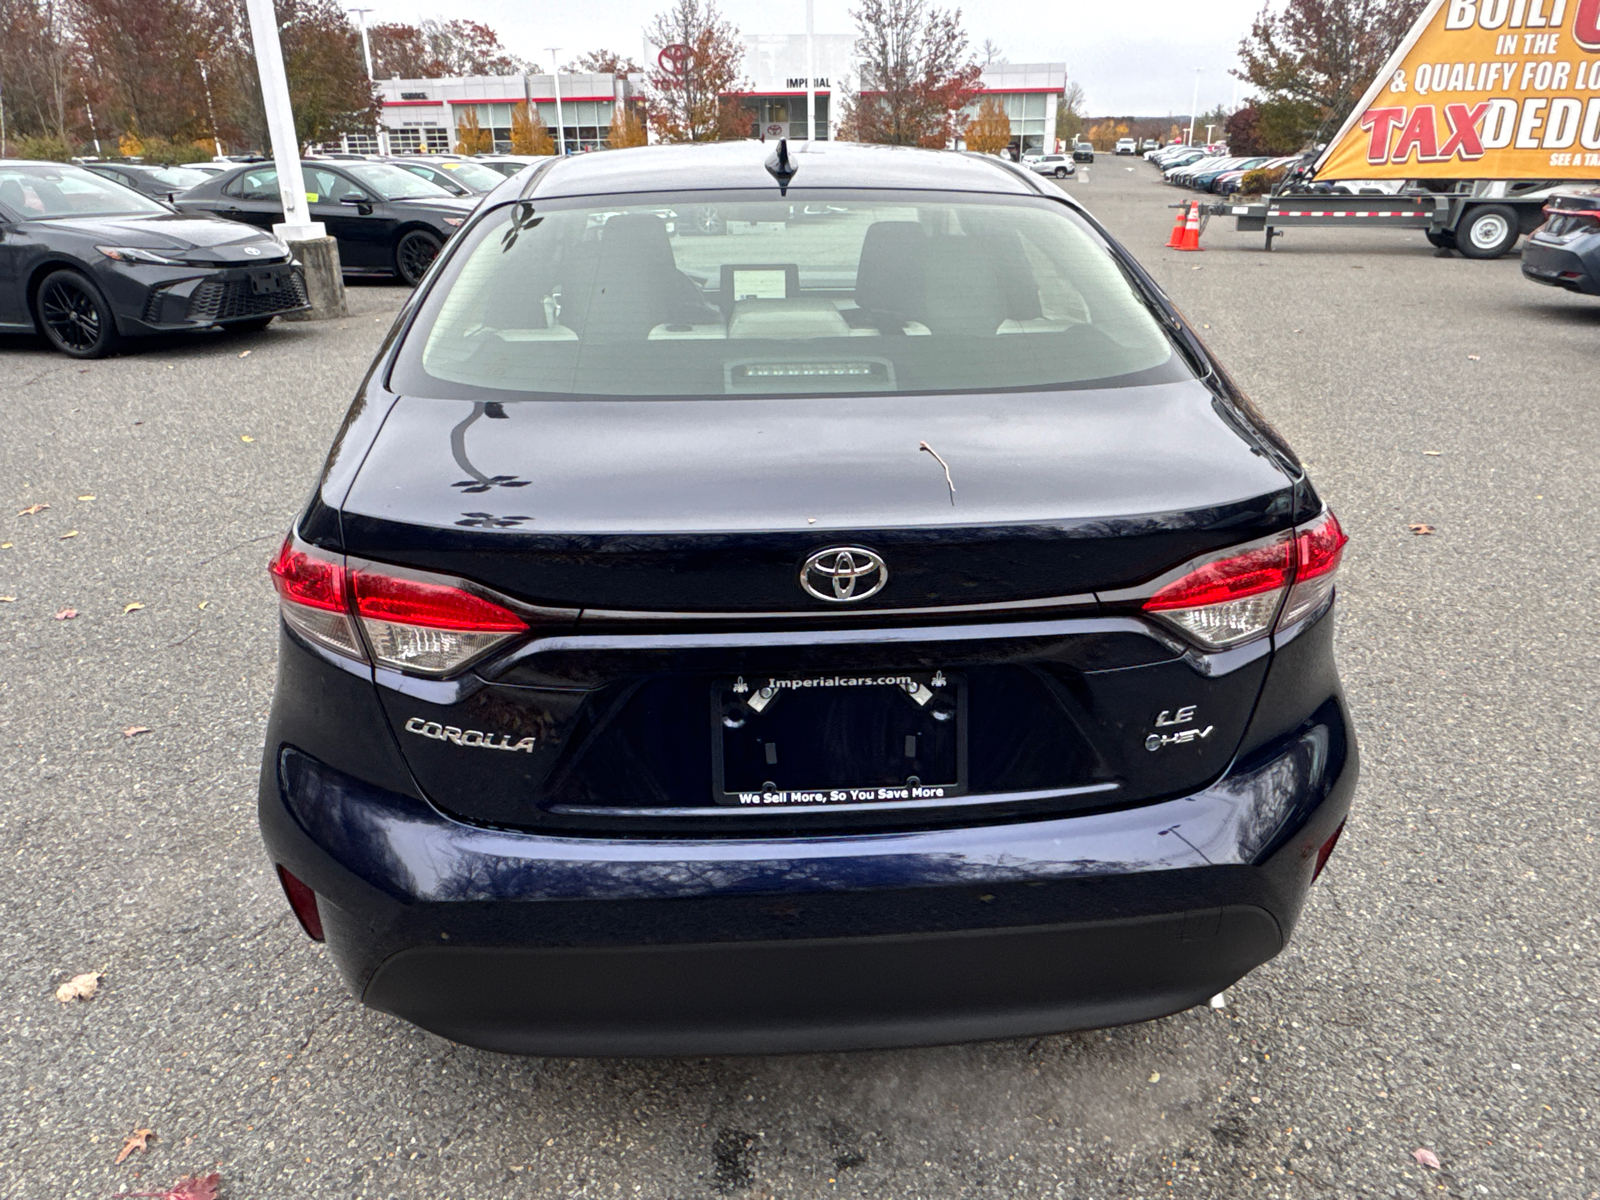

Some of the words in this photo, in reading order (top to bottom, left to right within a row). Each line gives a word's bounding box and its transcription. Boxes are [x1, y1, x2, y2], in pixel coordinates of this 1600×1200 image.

[1495, 34, 1518, 55] IN
[1523, 33, 1560, 55] THE
[1390, 69, 1408, 93] &
[1414, 62, 1518, 95] QUALIFY
[1519, 61, 1571, 91] FOR
[1574, 61, 1600, 91] LO
[1360, 102, 1493, 163] TAX
[1549, 152, 1573, 167] SEE
[1572, 153, 1582, 167] A
[1584, 153, 1600, 167] TA
[768, 676, 912, 690] Imperialcars.com
[1155, 704, 1197, 728] LE
[404, 717, 536, 754] COROLLA
[739, 793, 760, 804] We
[763, 792, 787, 804] Sell
[791, 791, 827, 804] More,
[830, 790, 847, 802] So
[850, 789, 875, 801] You
[877, 788, 908, 800] Save
[912, 786, 944, 798] More
